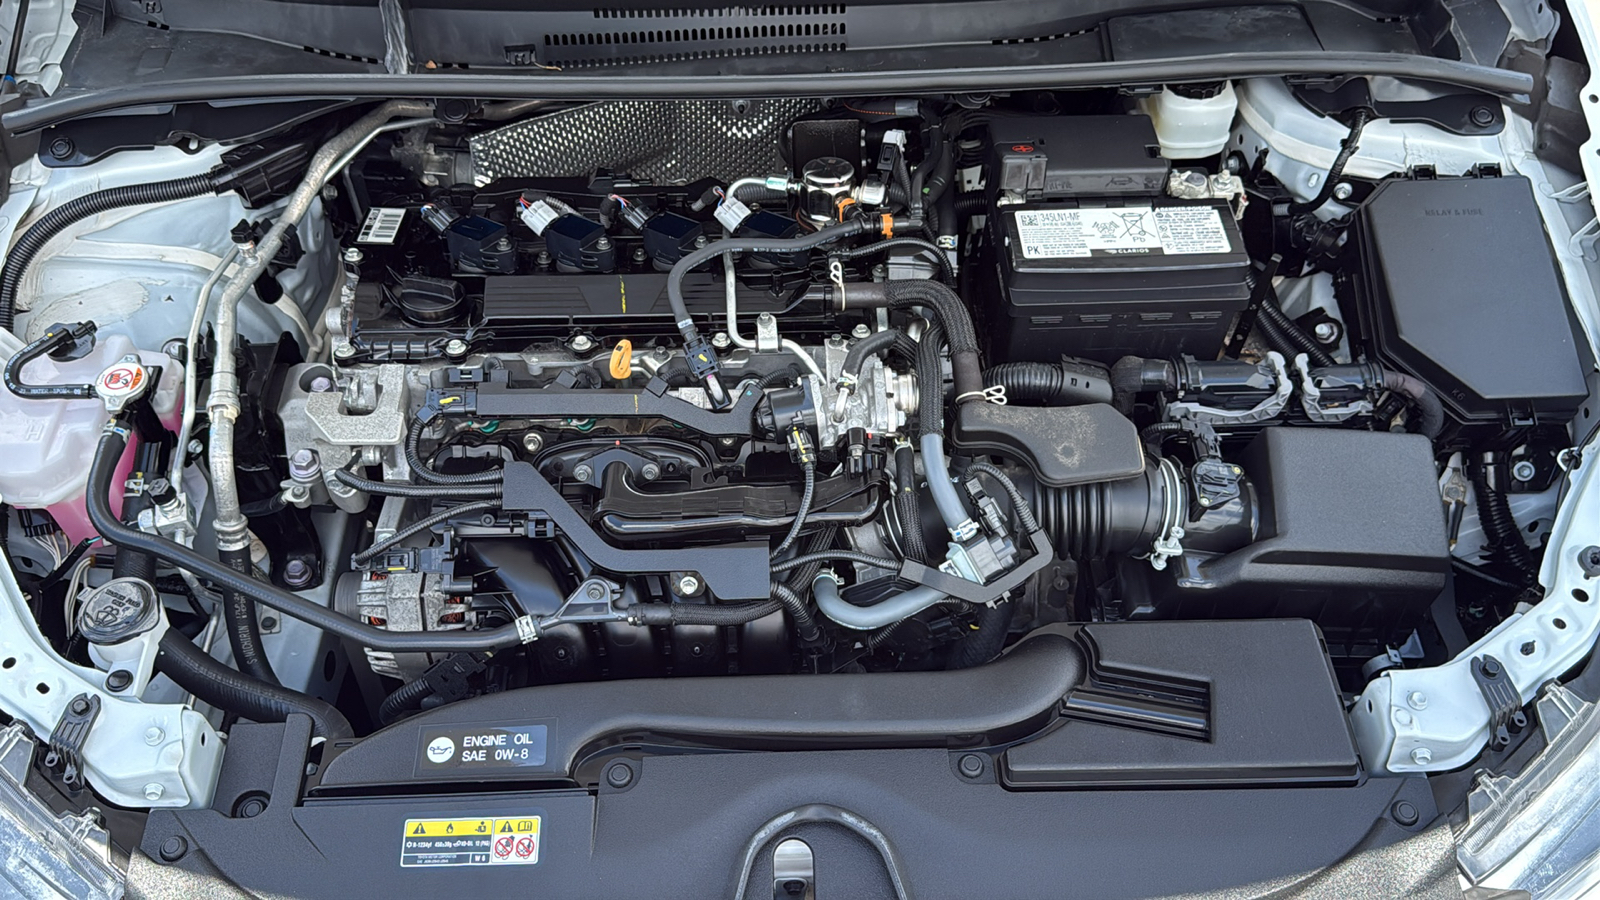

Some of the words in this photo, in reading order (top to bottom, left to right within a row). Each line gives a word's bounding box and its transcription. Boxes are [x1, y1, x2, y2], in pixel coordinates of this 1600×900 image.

[1027, 245, 1040, 255] PK
[463, 735, 507, 748] ENGINE
[513, 733, 534, 745] OIL
[462, 750, 487, 761] SAE
[494, 748, 529, 760] 0W-8
